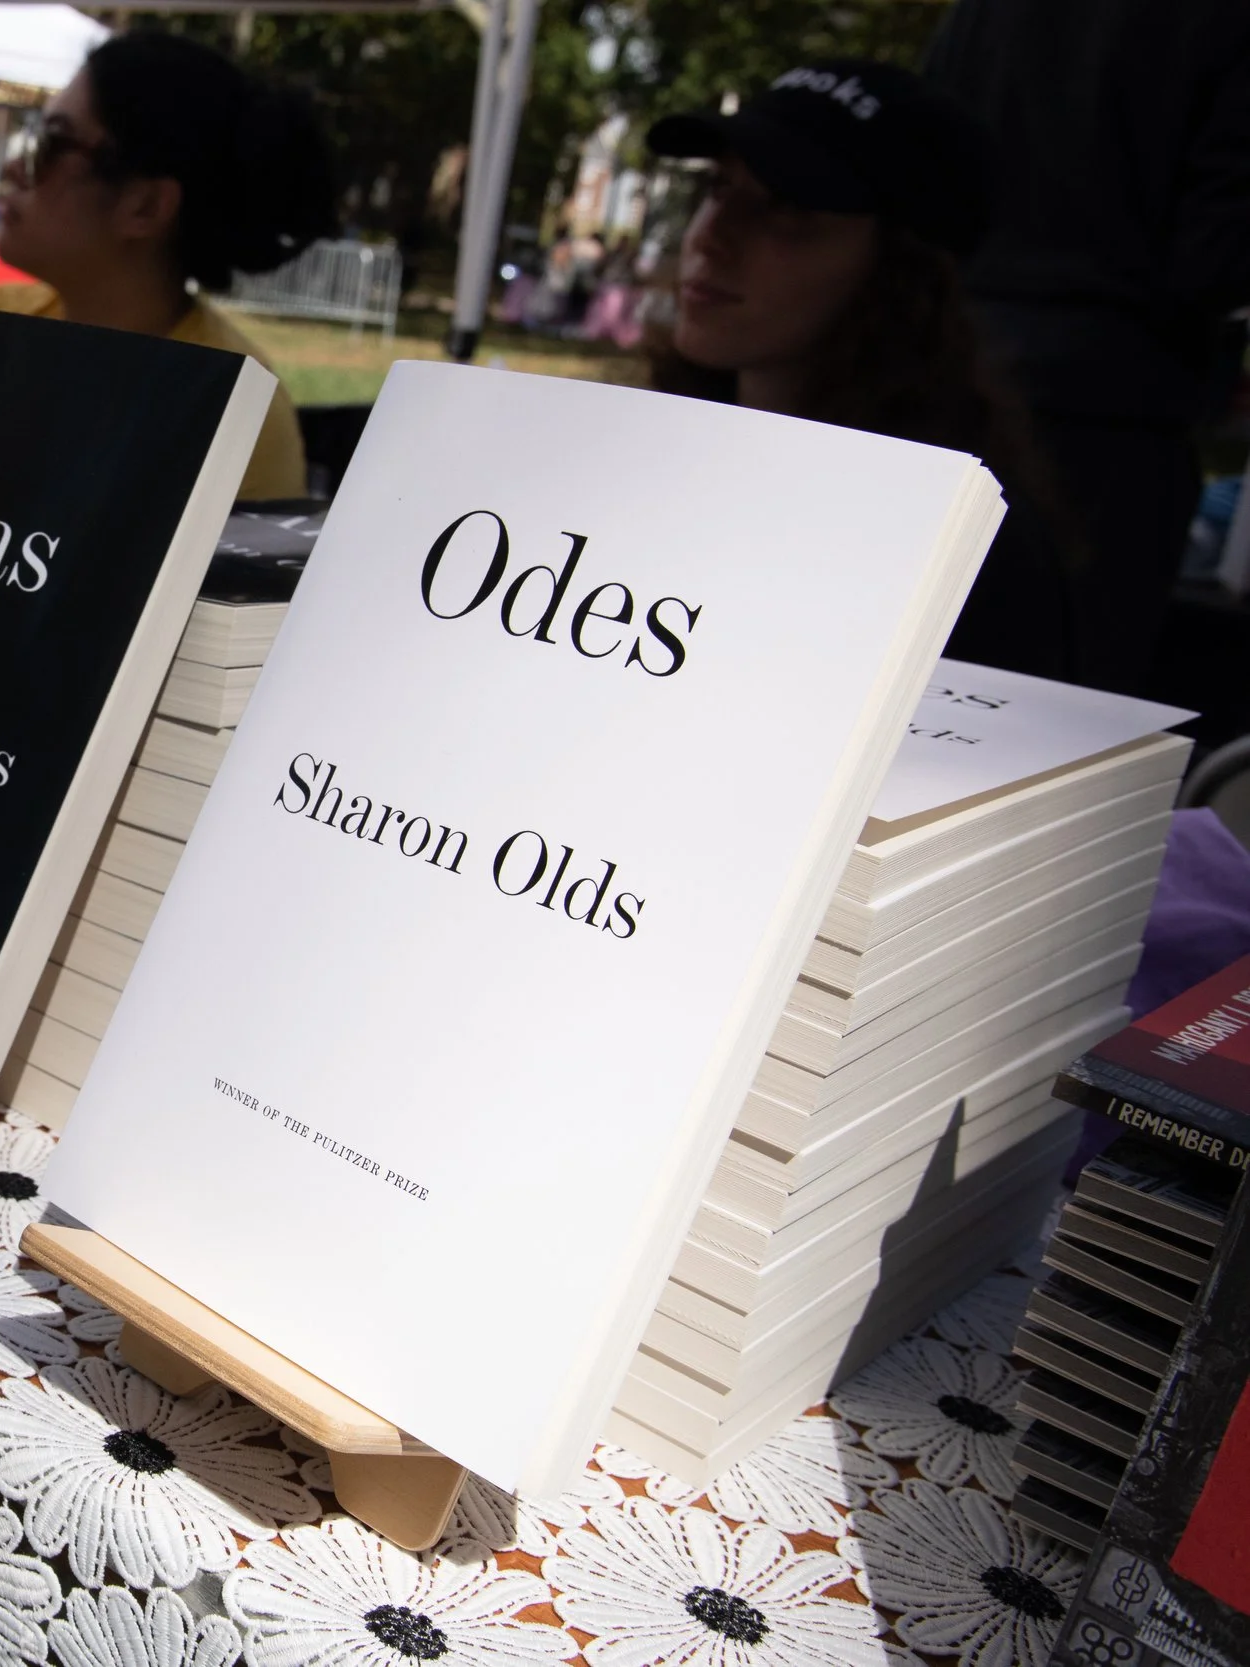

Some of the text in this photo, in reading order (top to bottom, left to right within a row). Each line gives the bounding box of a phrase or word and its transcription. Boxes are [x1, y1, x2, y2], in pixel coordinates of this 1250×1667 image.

[421, 510, 702, 677] Odes
[922, 685, 1010, 709] es
[908, 723, 983, 744] ds
[273, 753, 645, 939] Sharon Olds
[1150, 1009, 1249, 1065] MAHOGANY
[213, 1077, 429, 1201] WINNER OF THE PULITZER PRIZE
[1106, 1097, 1116, 1116] I
[1118, 1102, 1224, 1160] REMEMBER
